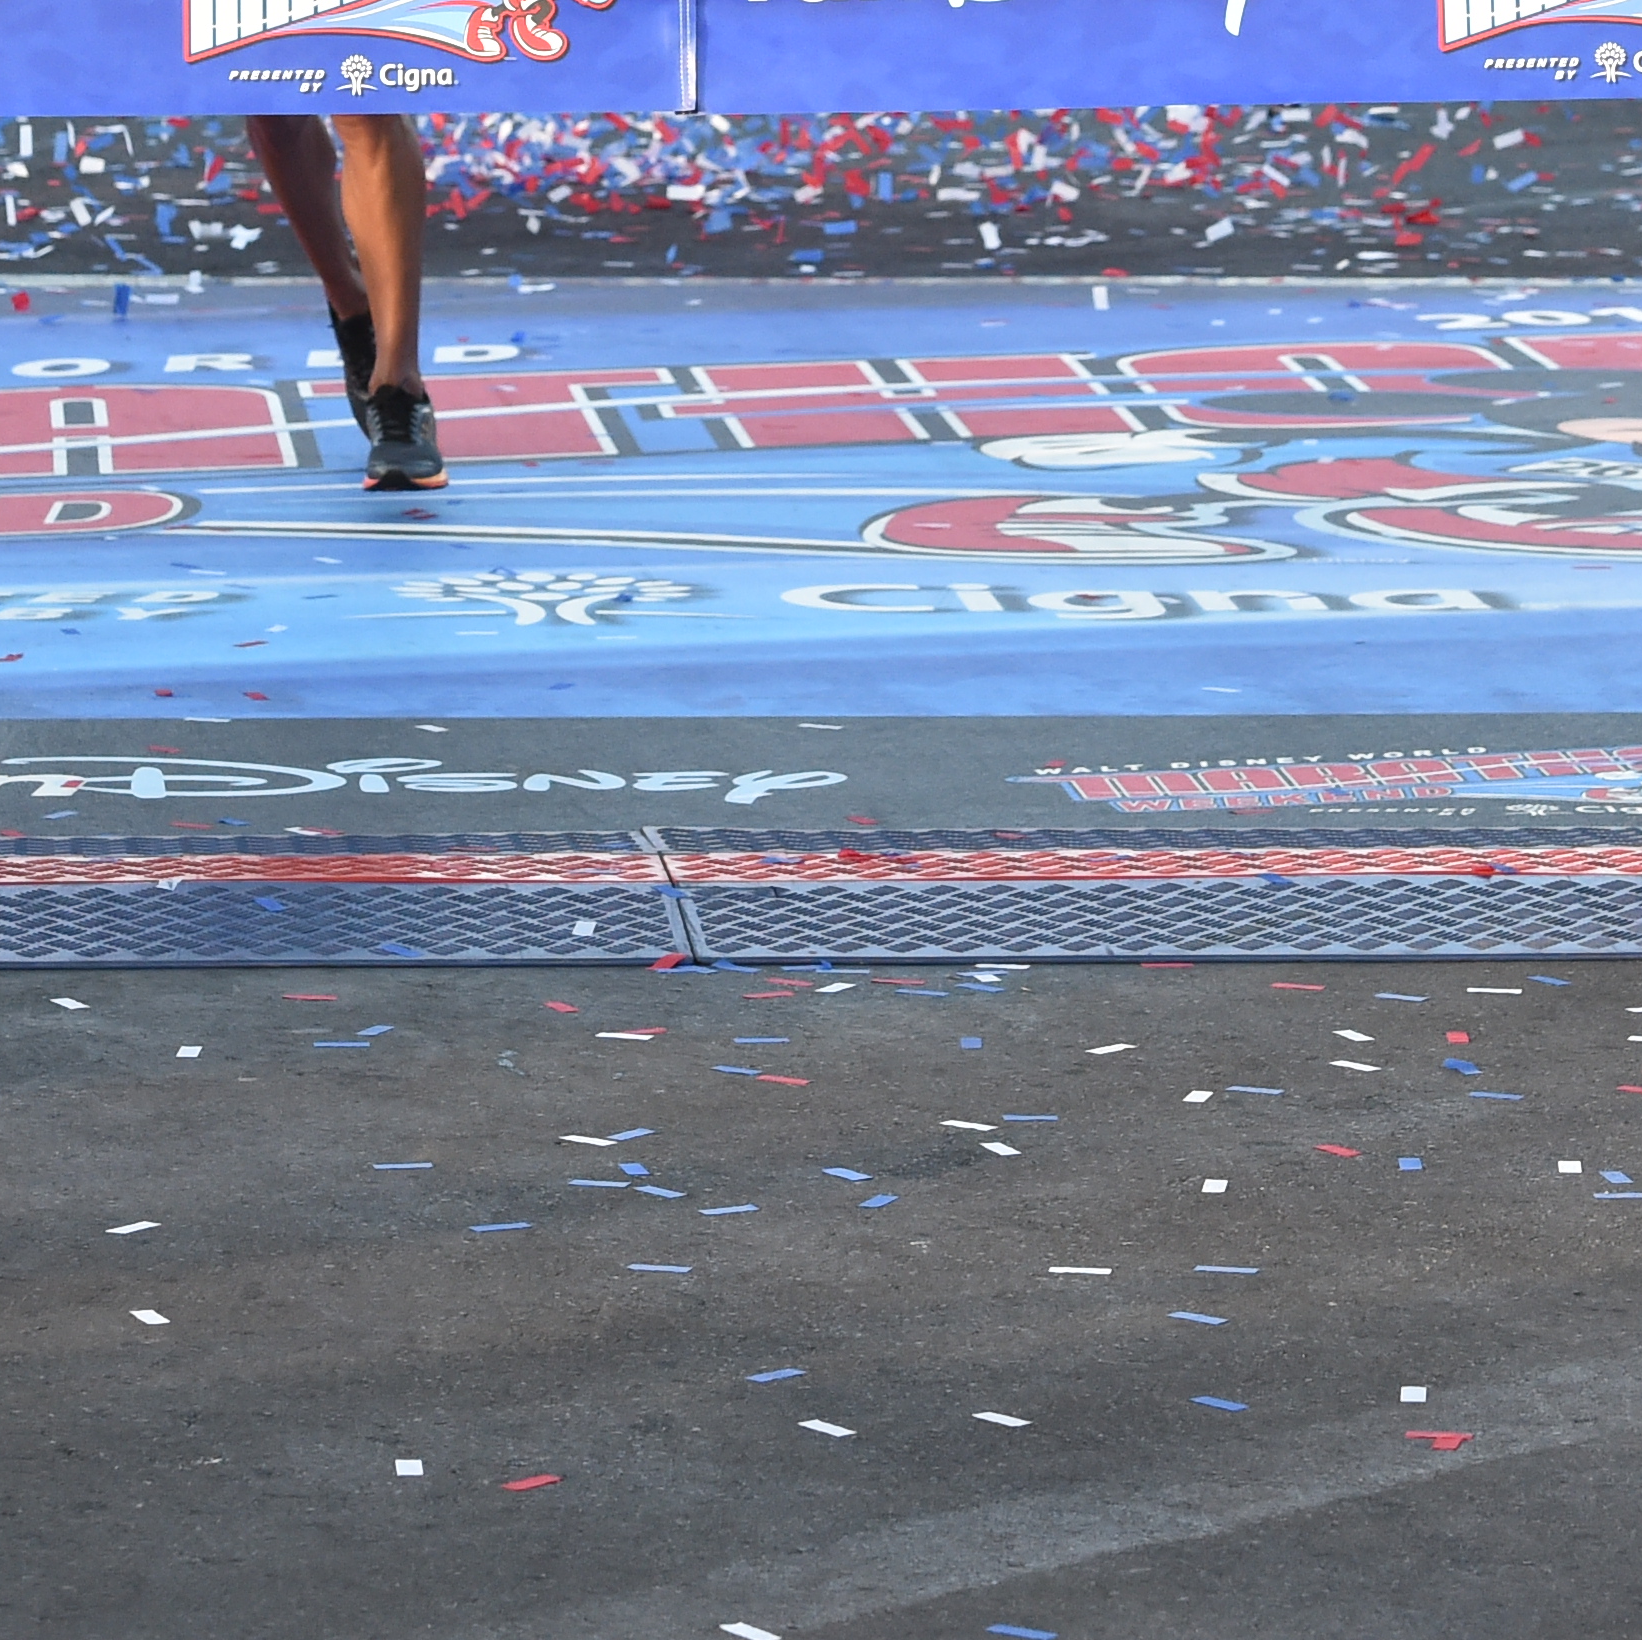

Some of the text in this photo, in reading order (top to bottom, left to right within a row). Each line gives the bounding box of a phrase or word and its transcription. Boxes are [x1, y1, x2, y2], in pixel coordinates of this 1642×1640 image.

[1483, 56, 1579, 70] PRESENTED
[228, 68, 326, 82] PRESENTED
[379, 62, 454, 93] Cigna
[1554, 69, 1577, 81] BY
[300, 82, 323, 93] BY
[780, 582, 1497, 619] Cigna
[1034, 746, 1487, 776] WALT DISNEY WORLD
